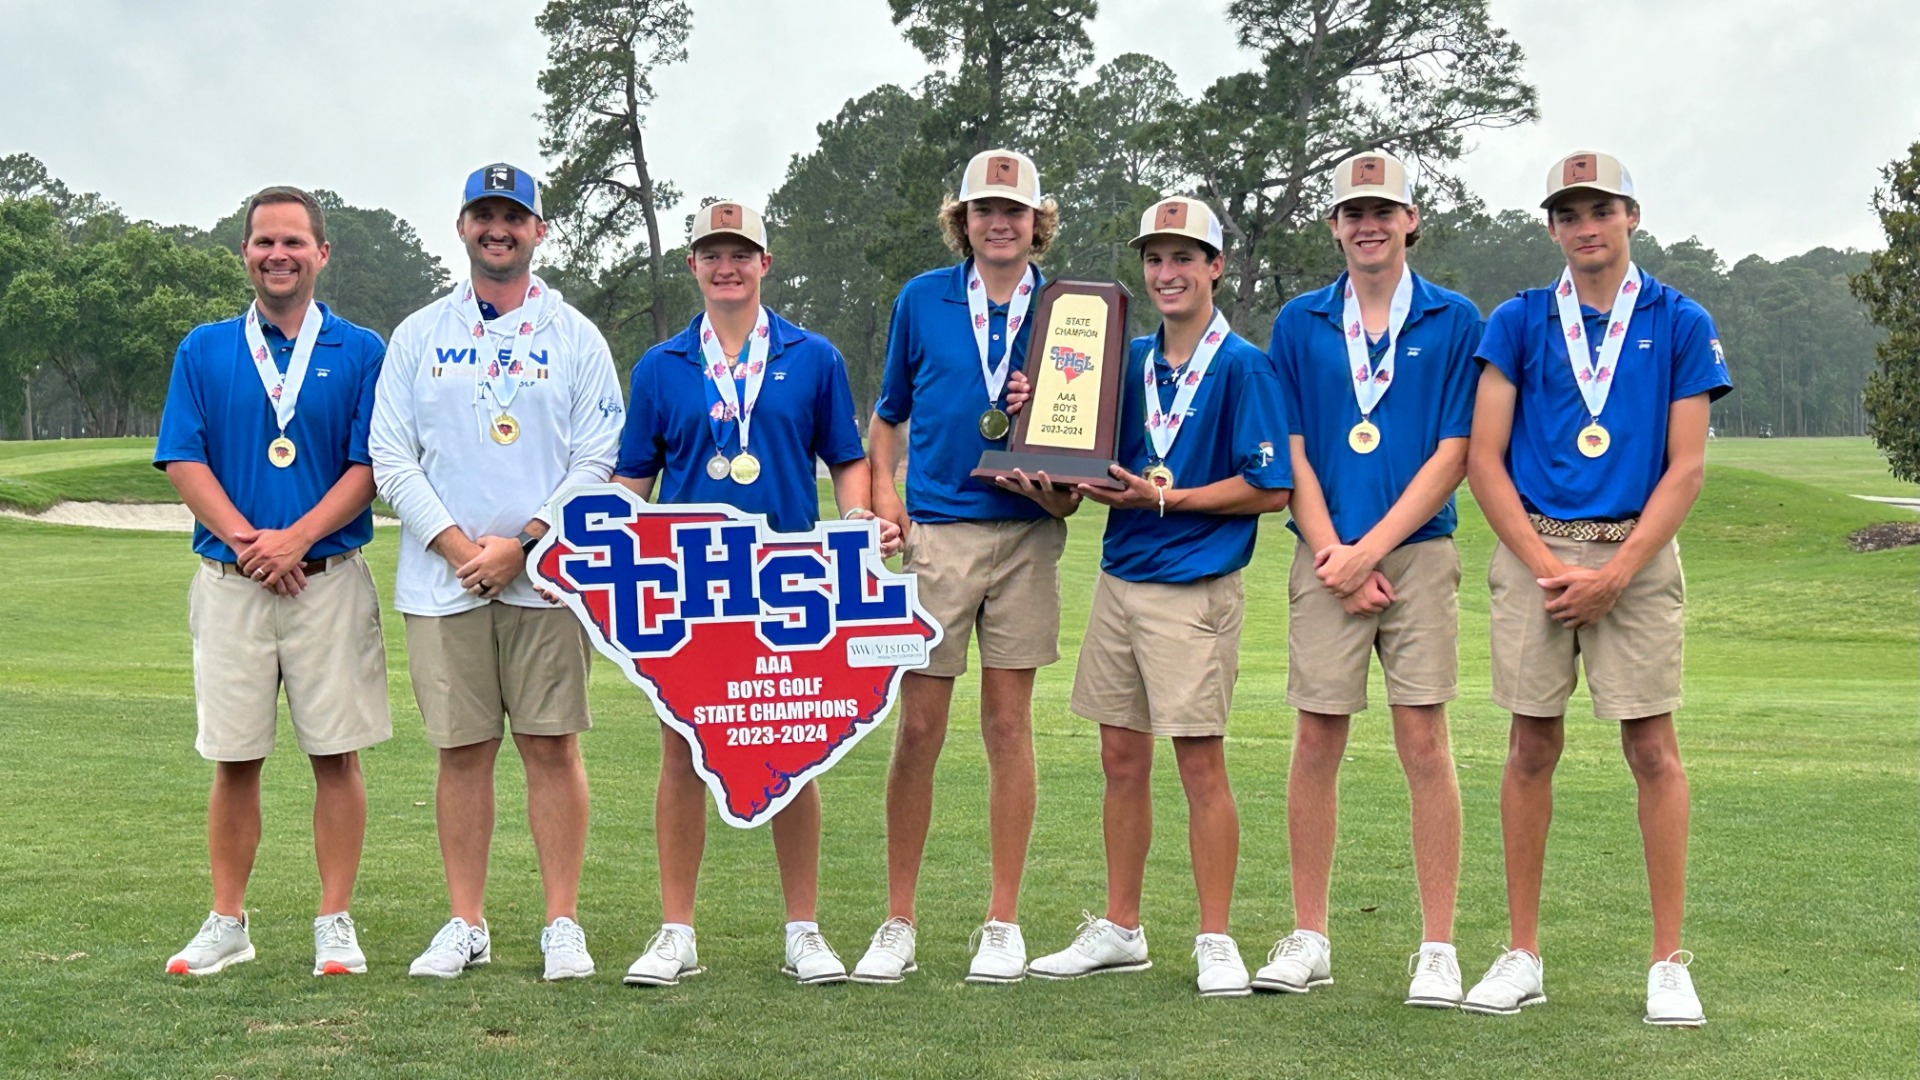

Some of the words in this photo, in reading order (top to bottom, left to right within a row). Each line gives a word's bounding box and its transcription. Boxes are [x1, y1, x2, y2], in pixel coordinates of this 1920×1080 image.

[1065, 317, 1091, 327] STATE
[1055, 327, 1098, 338] CHAMPION
[1050, 346, 1094, 373] SCHSL
[1057, 392, 1076, 402] AAA
[1053, 403, 1078, 413] BOYS
[1051, 414, 1076, 424] GOLF
[1041, 424, 1083, 436] 2023-2024
[563, 494, 907, 653] SCHSL
[875, 643, 919, 654] VISION
[755, 655, 793, 675] AAA
[727, 679, 775, 699] BOYS
[779, 677, 823, 697] GOLF
[693, 704, 747, 724] STATE
[749, 698, 859, 722] CHAMPIONS
[726, 723, 828, 747] 2023-2024
